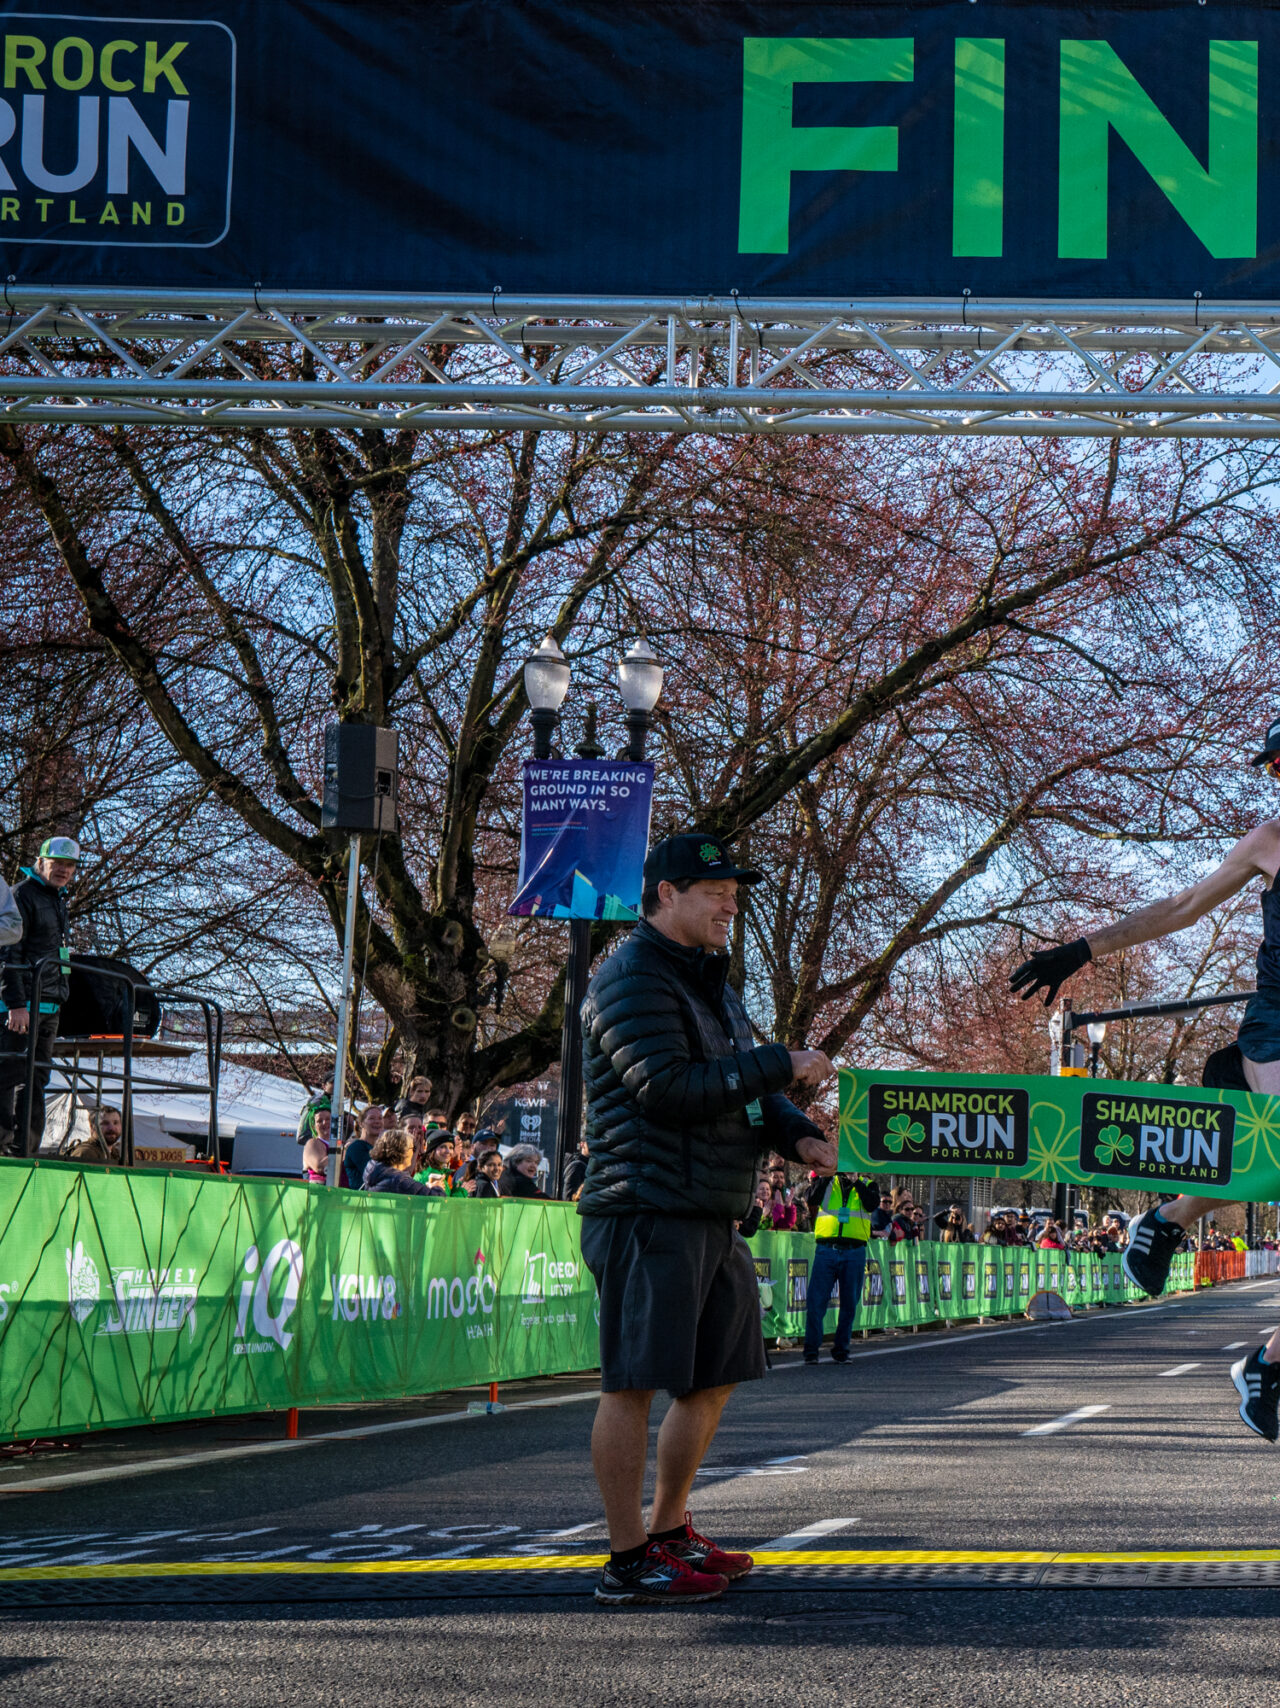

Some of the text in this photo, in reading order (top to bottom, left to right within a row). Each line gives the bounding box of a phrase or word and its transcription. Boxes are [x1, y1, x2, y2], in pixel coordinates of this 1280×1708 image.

[0, 94, 190, 196] UN
[530, 770, 646, 784] WE'RE BREAKING
[530, 785, 631, 798] GROUND IN SO
[531, 799, 610, 812] MANY WAYS.
[883, 1090, 1015, 1115] SHAMROCK
[1096, 1100, 1221, 1131] SHAMROCK
[931, 1113, 1015, 1149] RUN
[931, 1148, 1015, 1160] PORTLAND
[1140, 1125, 1220, 1168] RUN
[1139, 1162, 1219, 1179] PORTLAND
[134, 1268, 197, 1284] HONEY
[104, 1269, 197, 1344] STINGER
[234, 1239, 304, 1351] iQ
[332, 1274, 396, 1321] KGW8
[0, 1527, 280, 1548] PED
